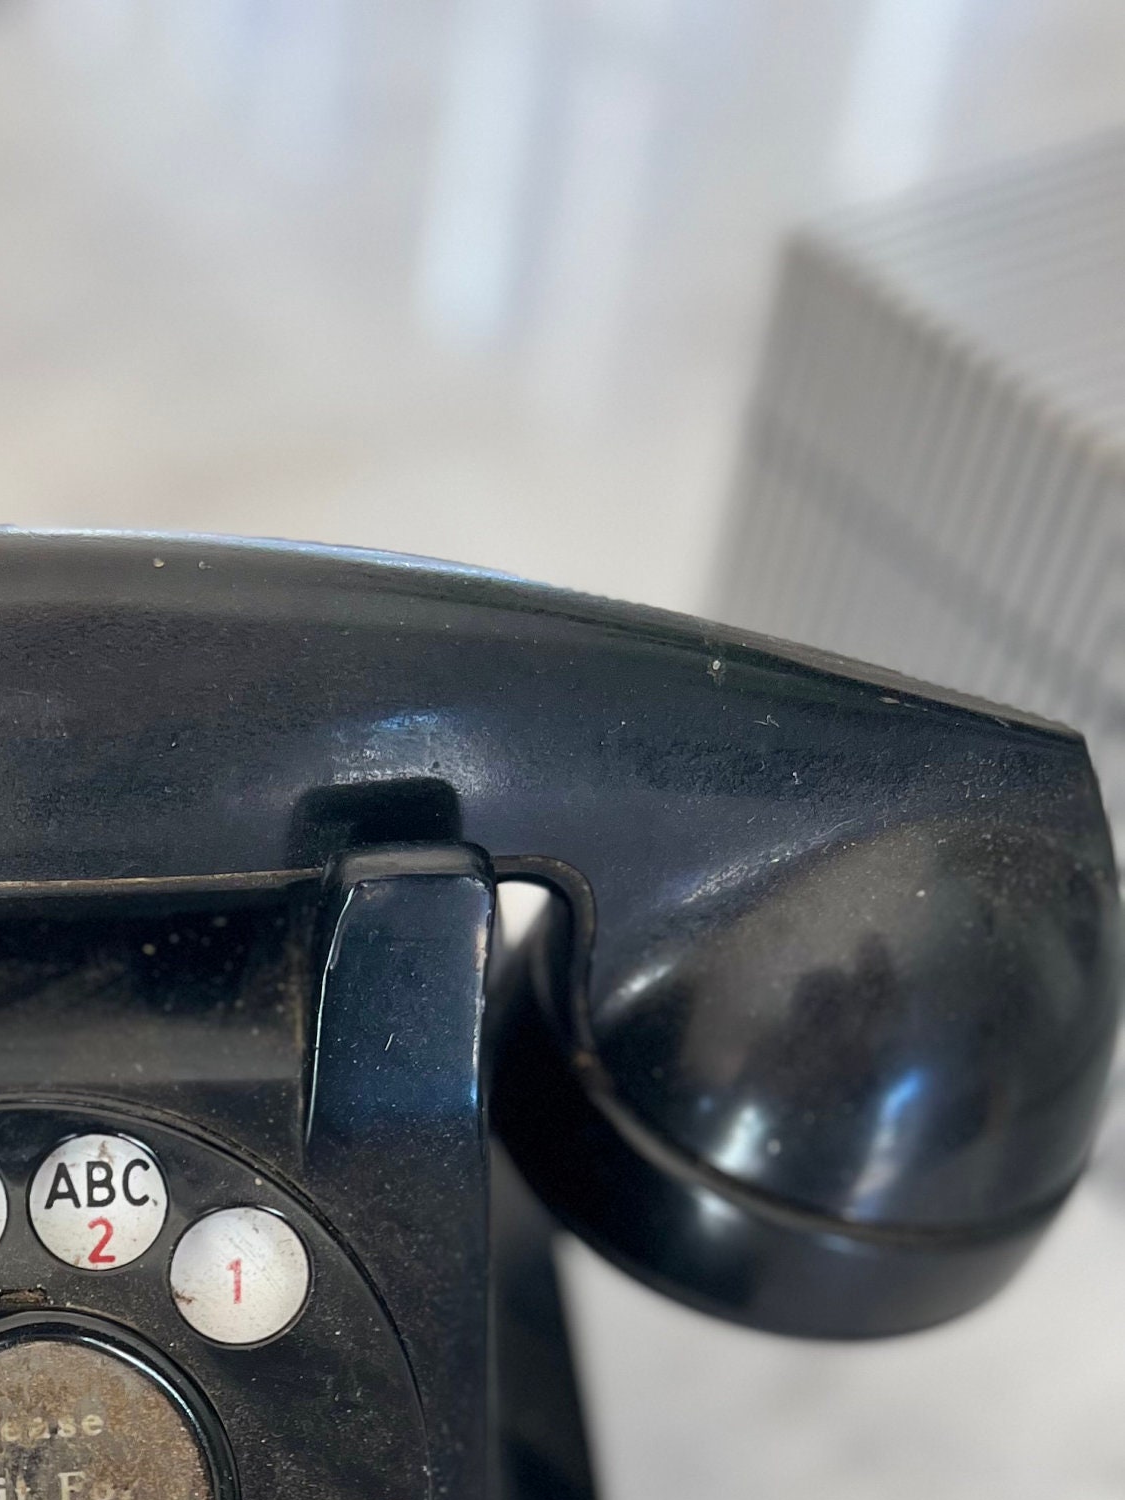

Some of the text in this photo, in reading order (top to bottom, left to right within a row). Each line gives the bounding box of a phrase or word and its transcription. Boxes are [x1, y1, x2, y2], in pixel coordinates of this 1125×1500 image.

[44, 1158, 151, 1209] ABC
[88, 1217, 116, 1263] 2
[227, 1258, 242, 1305] 1
